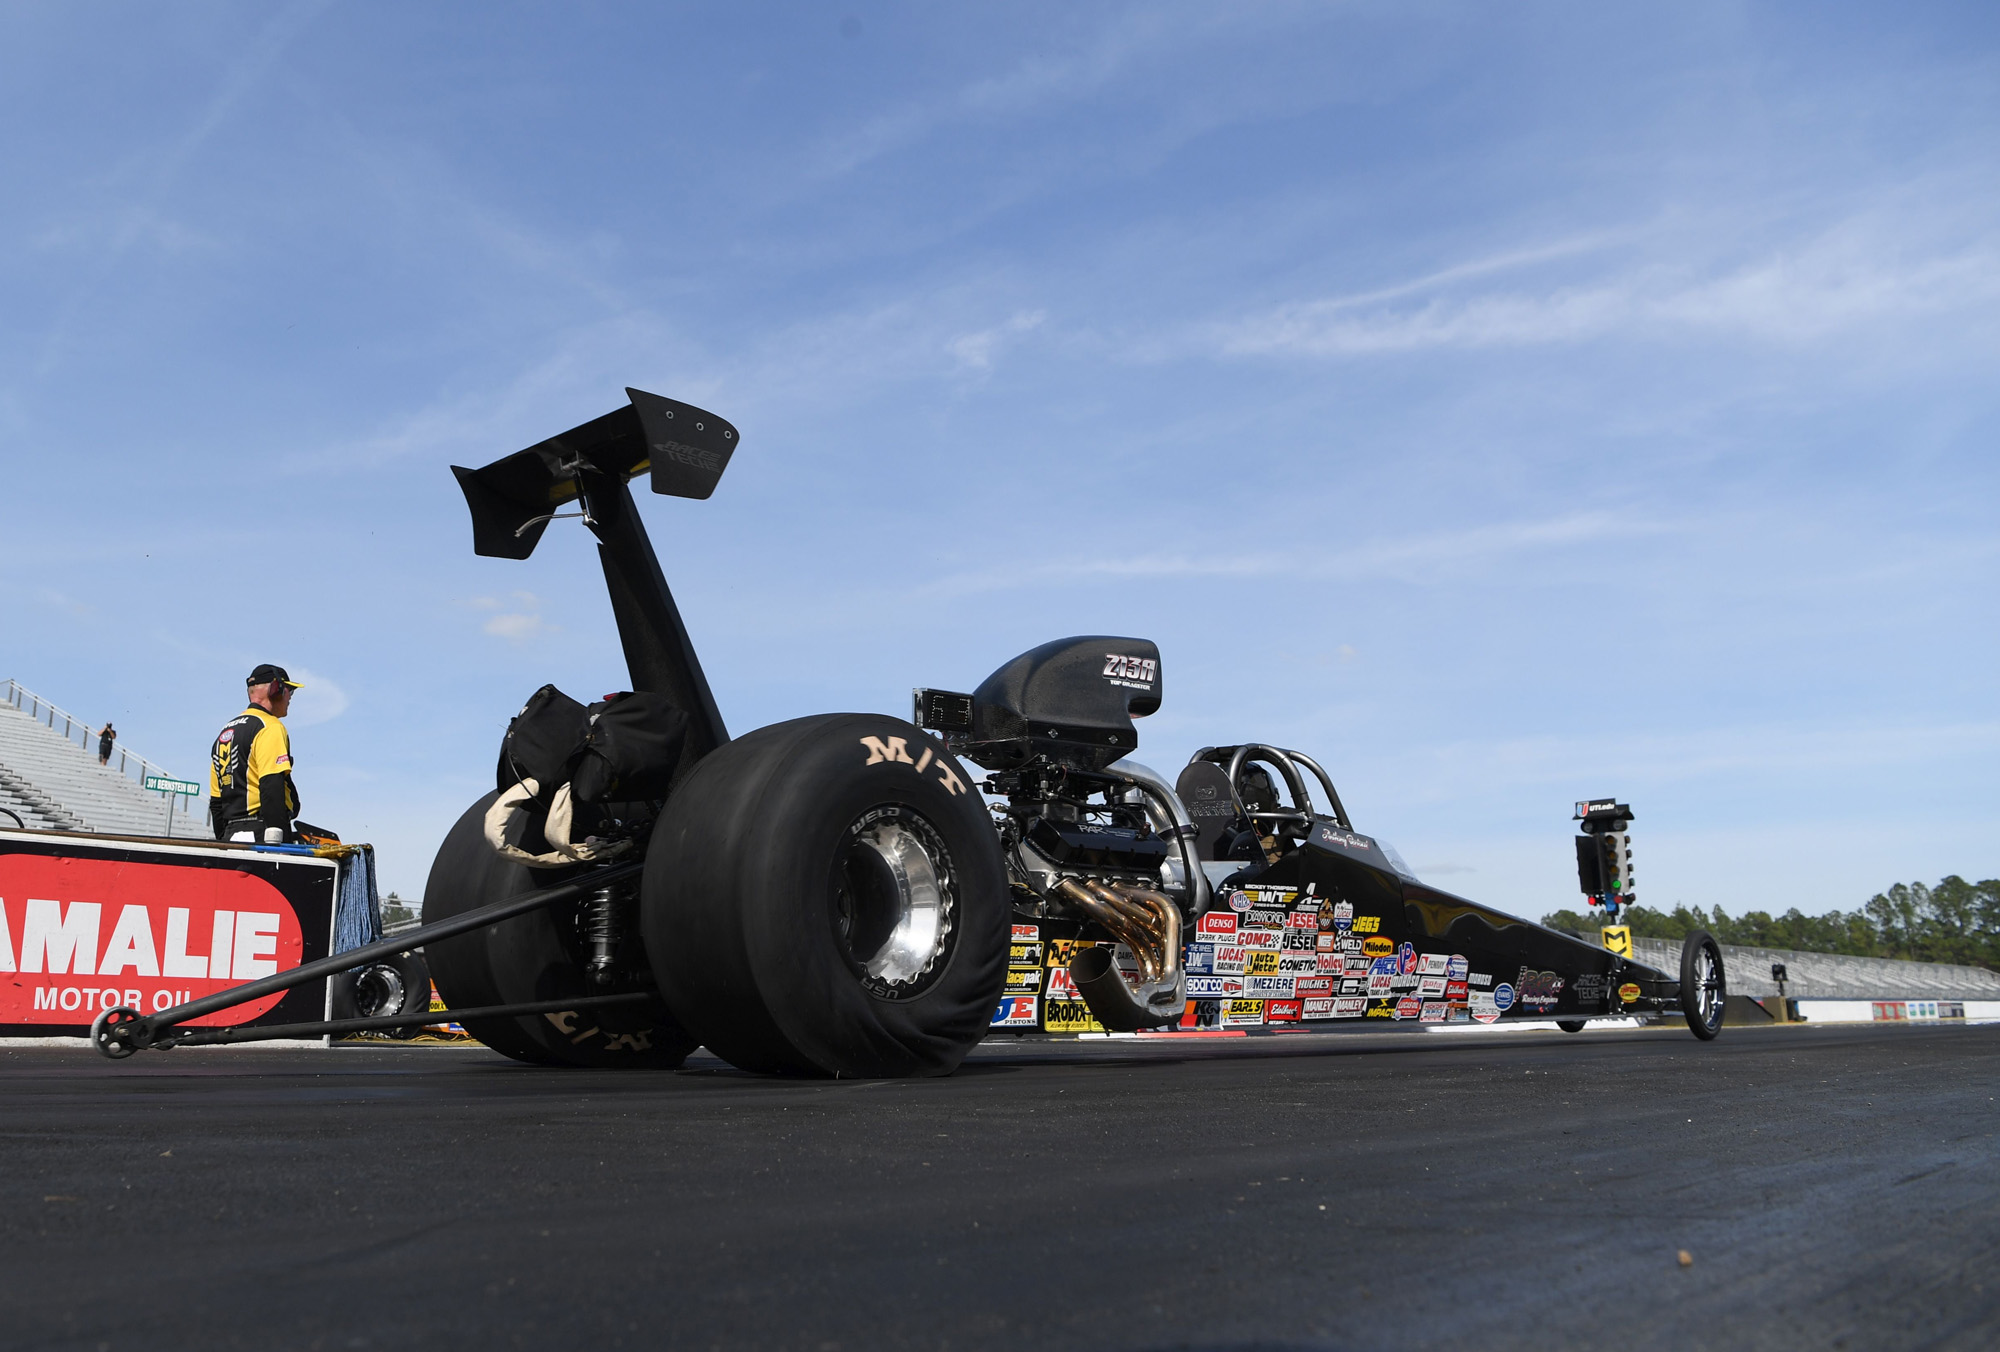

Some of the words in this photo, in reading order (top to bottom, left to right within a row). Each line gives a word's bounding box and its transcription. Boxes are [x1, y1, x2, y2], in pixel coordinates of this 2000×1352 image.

[1122, 681, 1151, 691] DRAGSTER
[860, 735, 968, 797] M/T
[157, 779, 187, 793] BERNSTEIN
[187, 783, 199, 795] WAY
[851, 807, 900, 835] WELD
[1258, 891, 1287, 903] M/T
[1208, 918, 1234, 929] DENSO
[1245, 910, 1286, 924] DIAMOND
[1285, 912, 1318, 929] JESEL
[0, 896, 281, 981] MALIE
[1218, 935, 1236, 943] PLUGS
[1237, 932, 1272, 945] COMP
[1282, 934, 1317, 951] JESEL
[1341, 938, 1362, 951] WELD
[1217, 947, 1246, 961] LUCAS
[1255, 953, 1275, 963] Auto
[1216, 962, 1235, 971] RACING
[1253, 963, 1278, 973] Meter
[1279, 959, 1317, 971] COMETIC
[1317, 955, 1344, 974] Holley
[861, 977, 899, 999] USA
[1187, 978, 1223, 995] sparco
[1253, 977, 1295, 990] MEZIERE
[1297, 979, 1331, 990] HUGHES
[1371, 976, 1392, 988] LUCAS
[33, 986, 143, 1012] MOTOR
[1337, 999, 1364, 1011] MANLEY
[991, 997, 1035, 1024] JE
[1230, 1001, 1263, 1013] EARL'S
[1305, 1000, 1334, 1012] MANLEY
[1367, 1008, 1396, 1018] IMPACT
